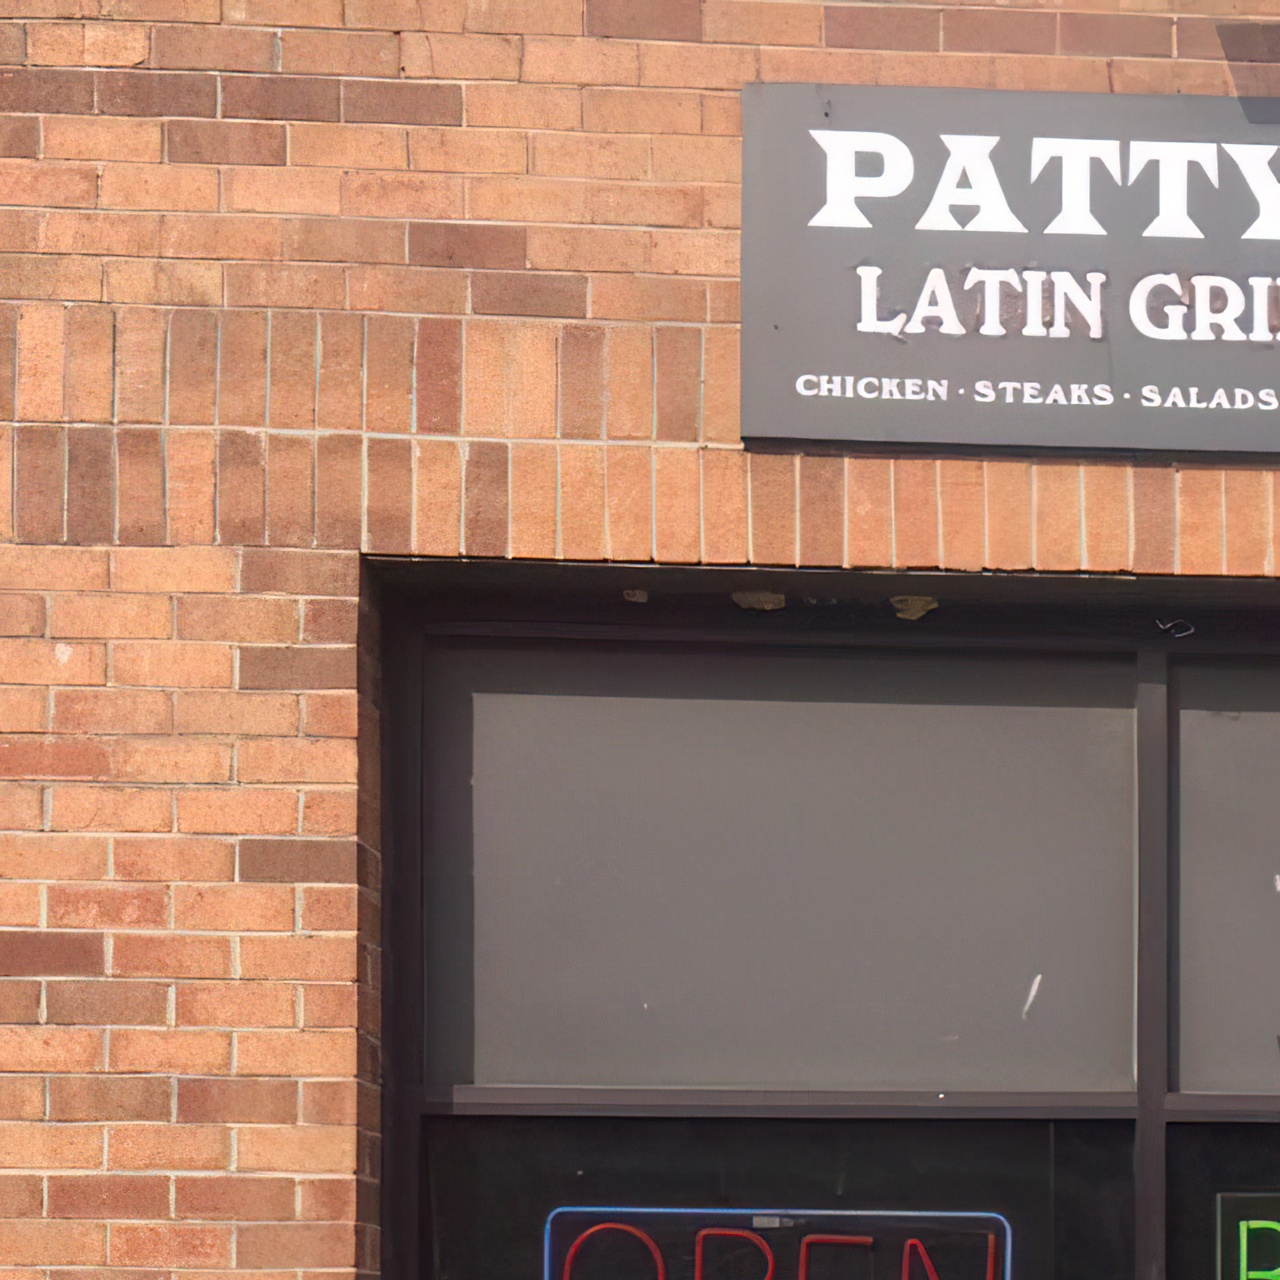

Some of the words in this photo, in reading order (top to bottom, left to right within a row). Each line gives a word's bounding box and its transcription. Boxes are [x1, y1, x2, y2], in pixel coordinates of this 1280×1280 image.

[856, 264, 1107, 339] LATIN
[795, 373, 949, 402] CHICKEN
[973, 379, 1115, 407] STEAKS
[1140, 384, 1280, 411] SALADS
